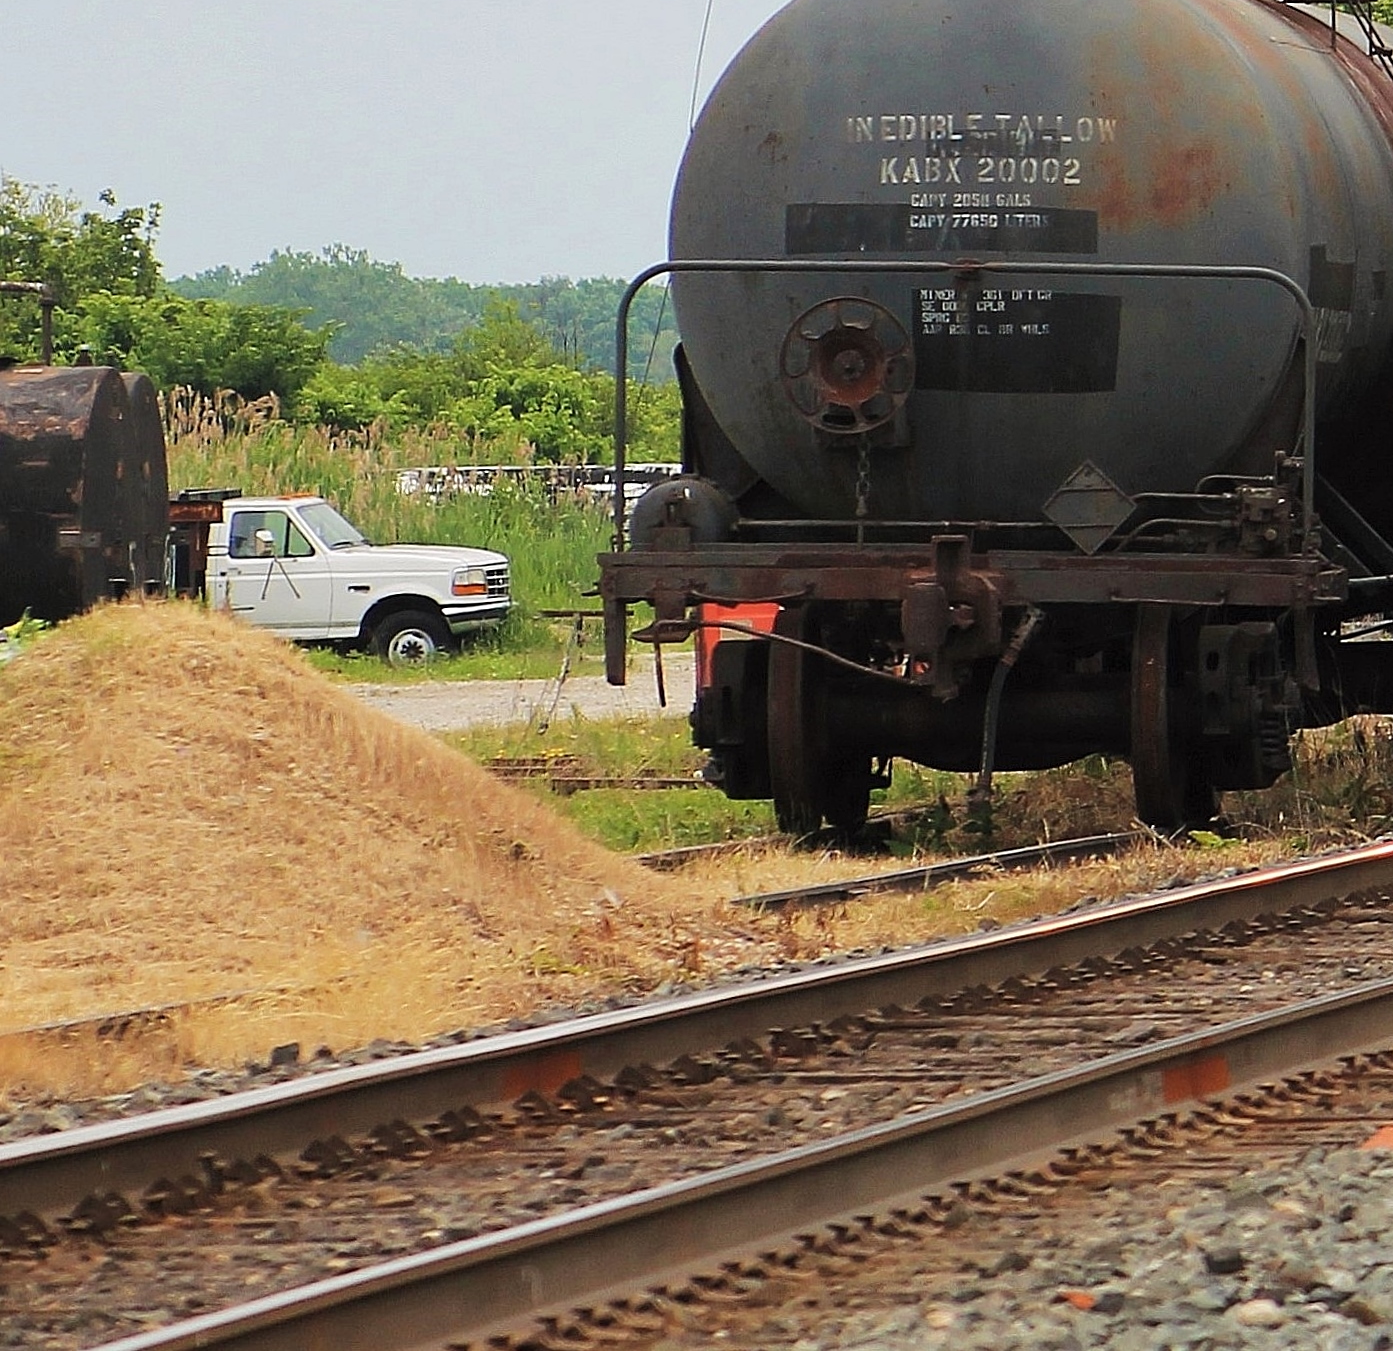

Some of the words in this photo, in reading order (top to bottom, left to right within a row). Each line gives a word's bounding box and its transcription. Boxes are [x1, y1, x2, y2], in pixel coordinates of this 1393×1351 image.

[993, 113, 1118, 144] TALLOW
[879, 156, 962, 185] KABX
[977, 156, 1082, 186] 20002
[996, 193, 1031, 207] GALS
[909, 213, 945, 228] CAPY
